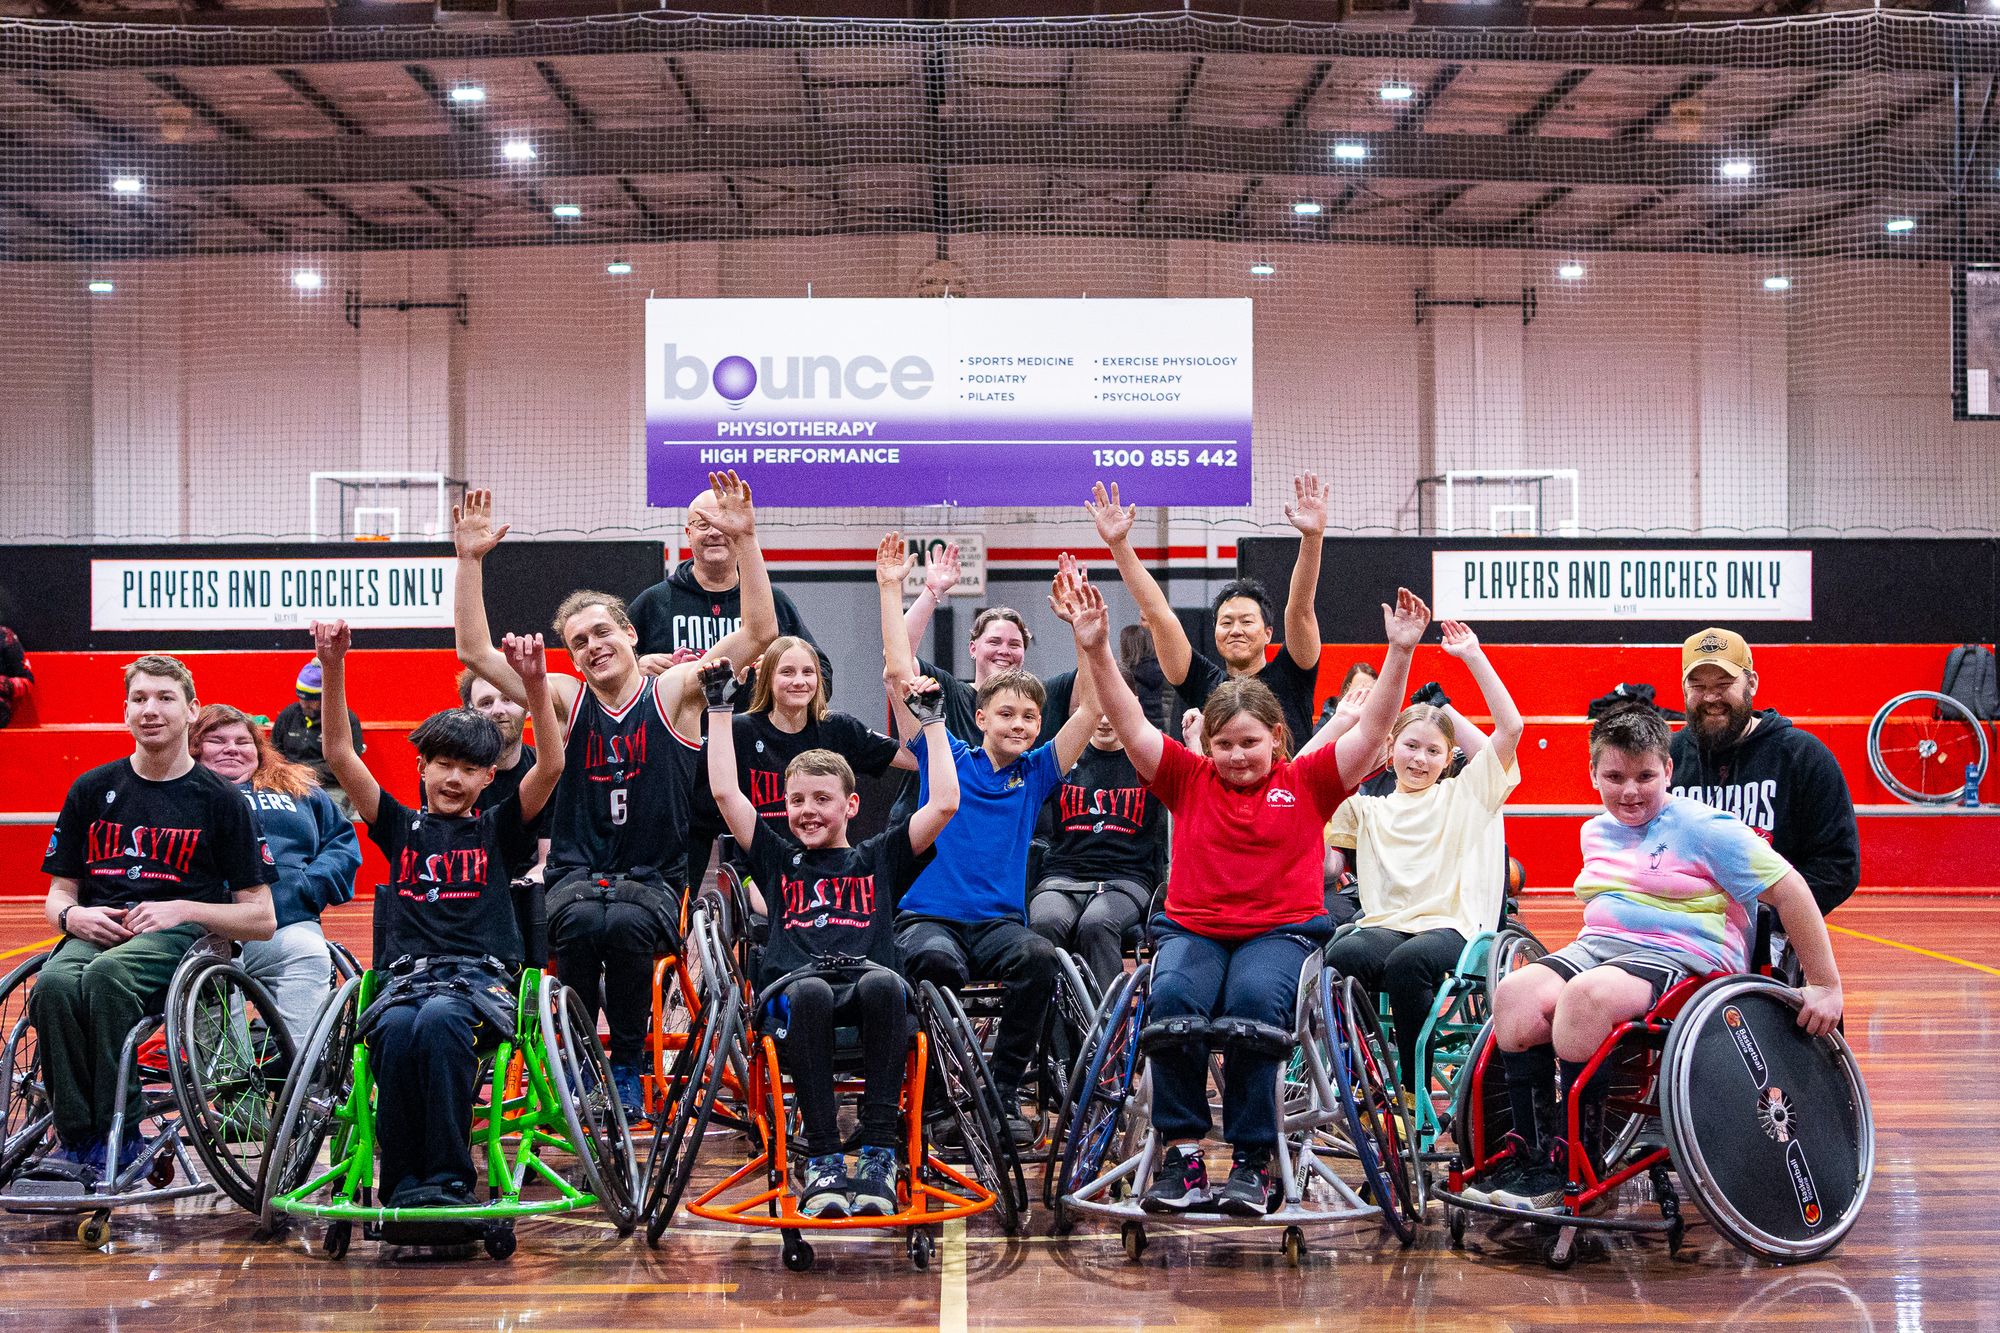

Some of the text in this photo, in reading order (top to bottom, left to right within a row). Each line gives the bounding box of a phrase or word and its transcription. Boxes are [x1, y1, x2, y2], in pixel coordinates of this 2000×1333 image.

[968, 357, 1074, 366] SPORTS MEDICINE
[1102, 357, 1238, 366] EXERCISE PHYSIOLOGY
[664, 343, 934, 400] bounce
[968, 374, 1027, 384] PODIATRY
[1102, 375, 1182, 384] MYOTHERAPY
[968, 392, 1015, 402] PILATES
[1102, 392, 1181, 402] PSYCHOLOGY
[717, 421, 877, 437] PHYSIOTHERAPY
[700, 448, 900, 464] HIGH PERFORMANCE
[1092, 449, 1238, 467] 1300 855 442
[123, 568, 443, 608] PLAYERS AND COACHES ONLY
[1464, 561, 1782, 599] PLAYERS AND COACHES ONLY
[610, 788, 627, 825] 6
[1059, 783, 1147, 827] KILSYTH
[85, 819, 202, 873] KILSYTH
[1739, 1028, 1764, 1071] Basketball
[1790, 1158, 1809, 1203] Basketball
